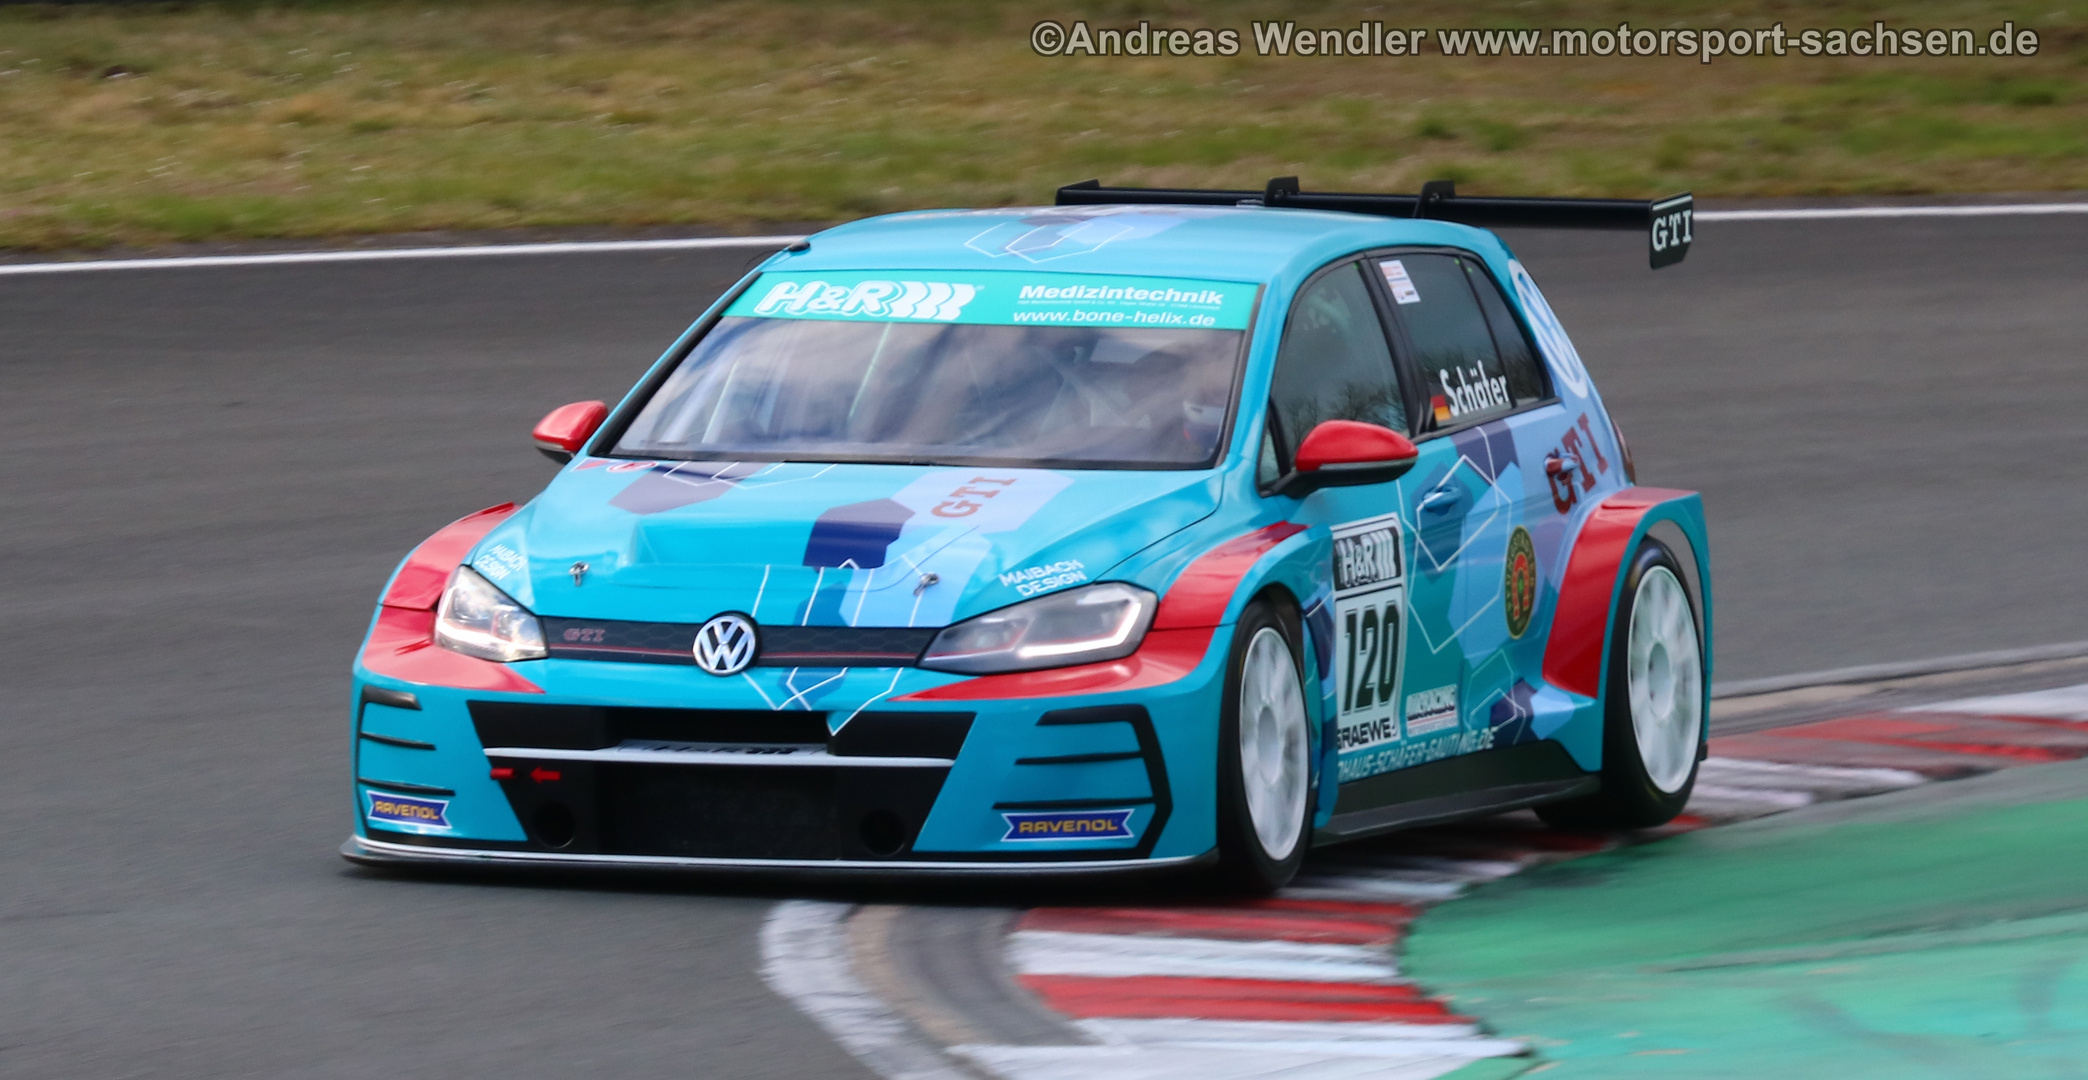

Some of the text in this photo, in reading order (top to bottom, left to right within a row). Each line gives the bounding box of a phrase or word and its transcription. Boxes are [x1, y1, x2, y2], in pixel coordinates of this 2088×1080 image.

[1651, 208, 1693, 252] GTI
[754, 280, 907, 317] H&R
[1019, 284, 1225, 305] Medizintechnik
[1012, 309, 1217, 327] www.bone-helix.de
[1439, 359, 1509, 417] Schäfer
[1544, 411, 1609, 515] GTI
[931, 476, 1018, 518] GTI
[998, 559, 1085, 587] MAIBACH
[1336, 532, 1381, 588] H&R
[1016, 570, 1088, 597] DESIGN
[563, 627, 606, 642] GTI
[1341, 600, 1400, 716] 120
[375, 800, 439, 820] RAVENOL
[1018, 818, 1119, 834] RAVENOL
